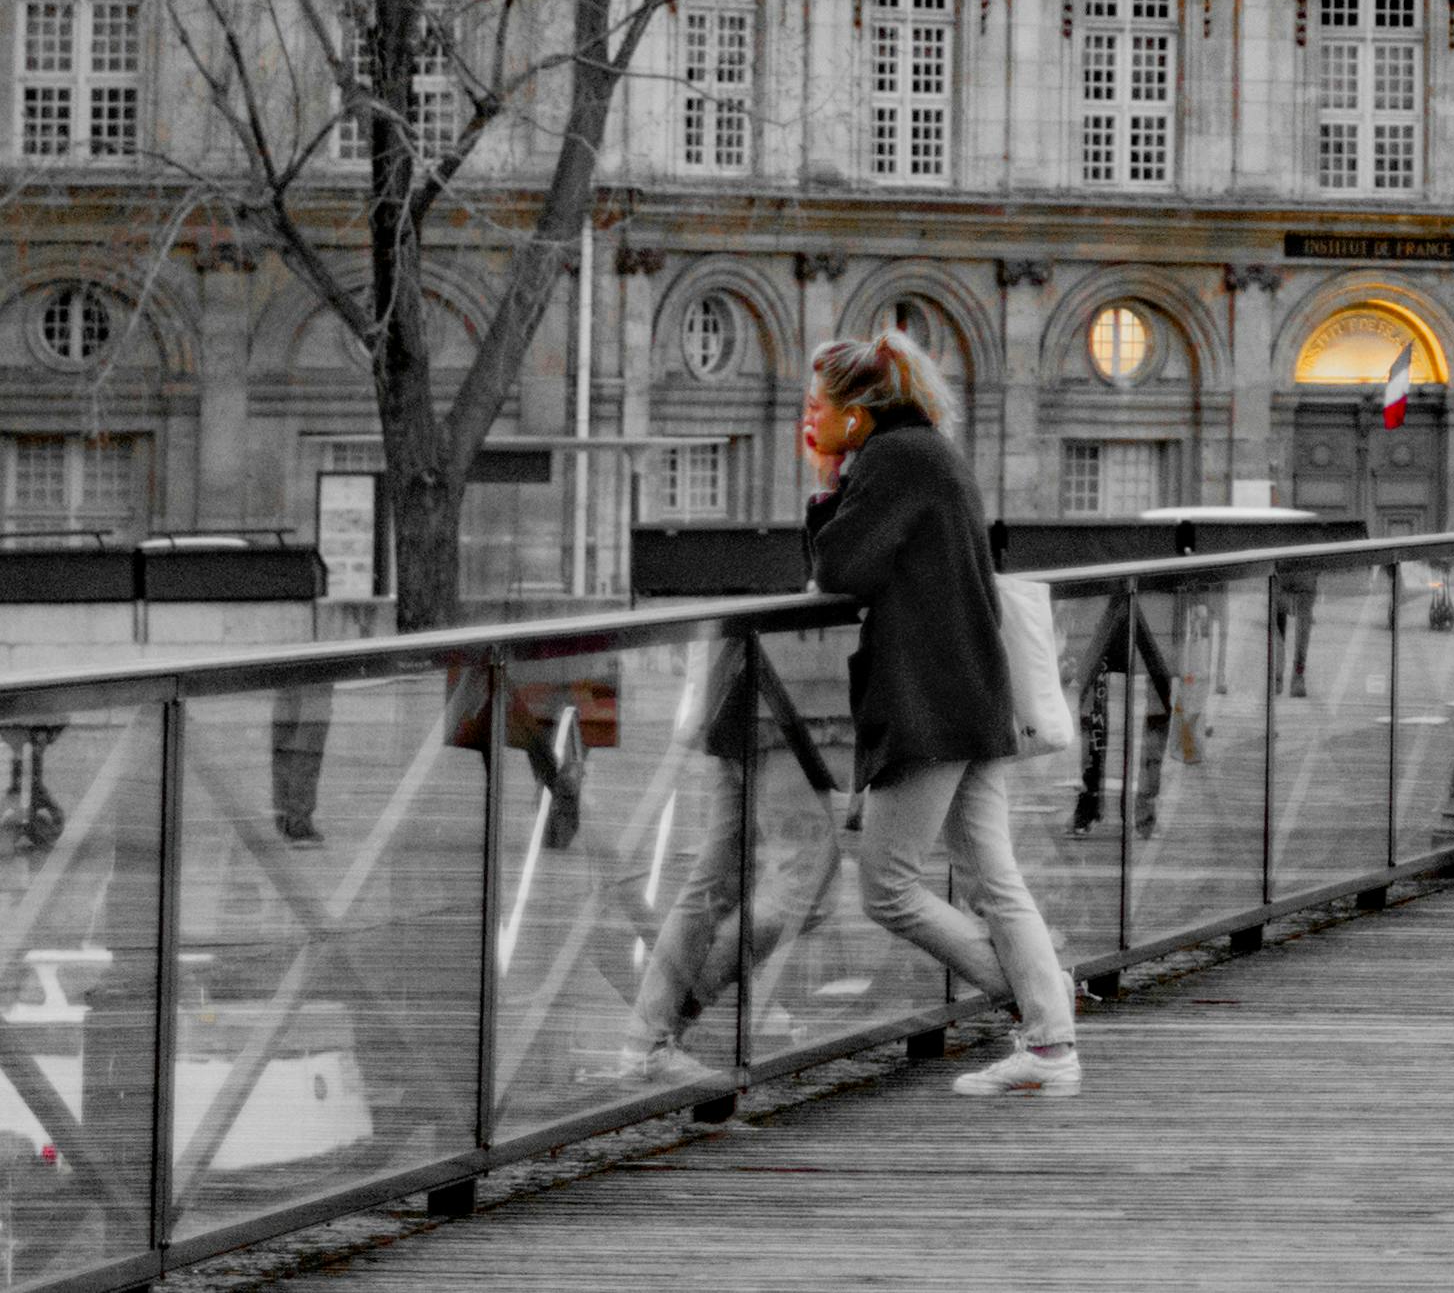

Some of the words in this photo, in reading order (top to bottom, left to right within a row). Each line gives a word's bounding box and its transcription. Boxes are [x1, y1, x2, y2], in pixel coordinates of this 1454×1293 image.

[1303, 238, 1368, 256] INSTITUT
[1374, 240, 1389, 256] DE
[1395, 241, 1452, 257] FRANCE
